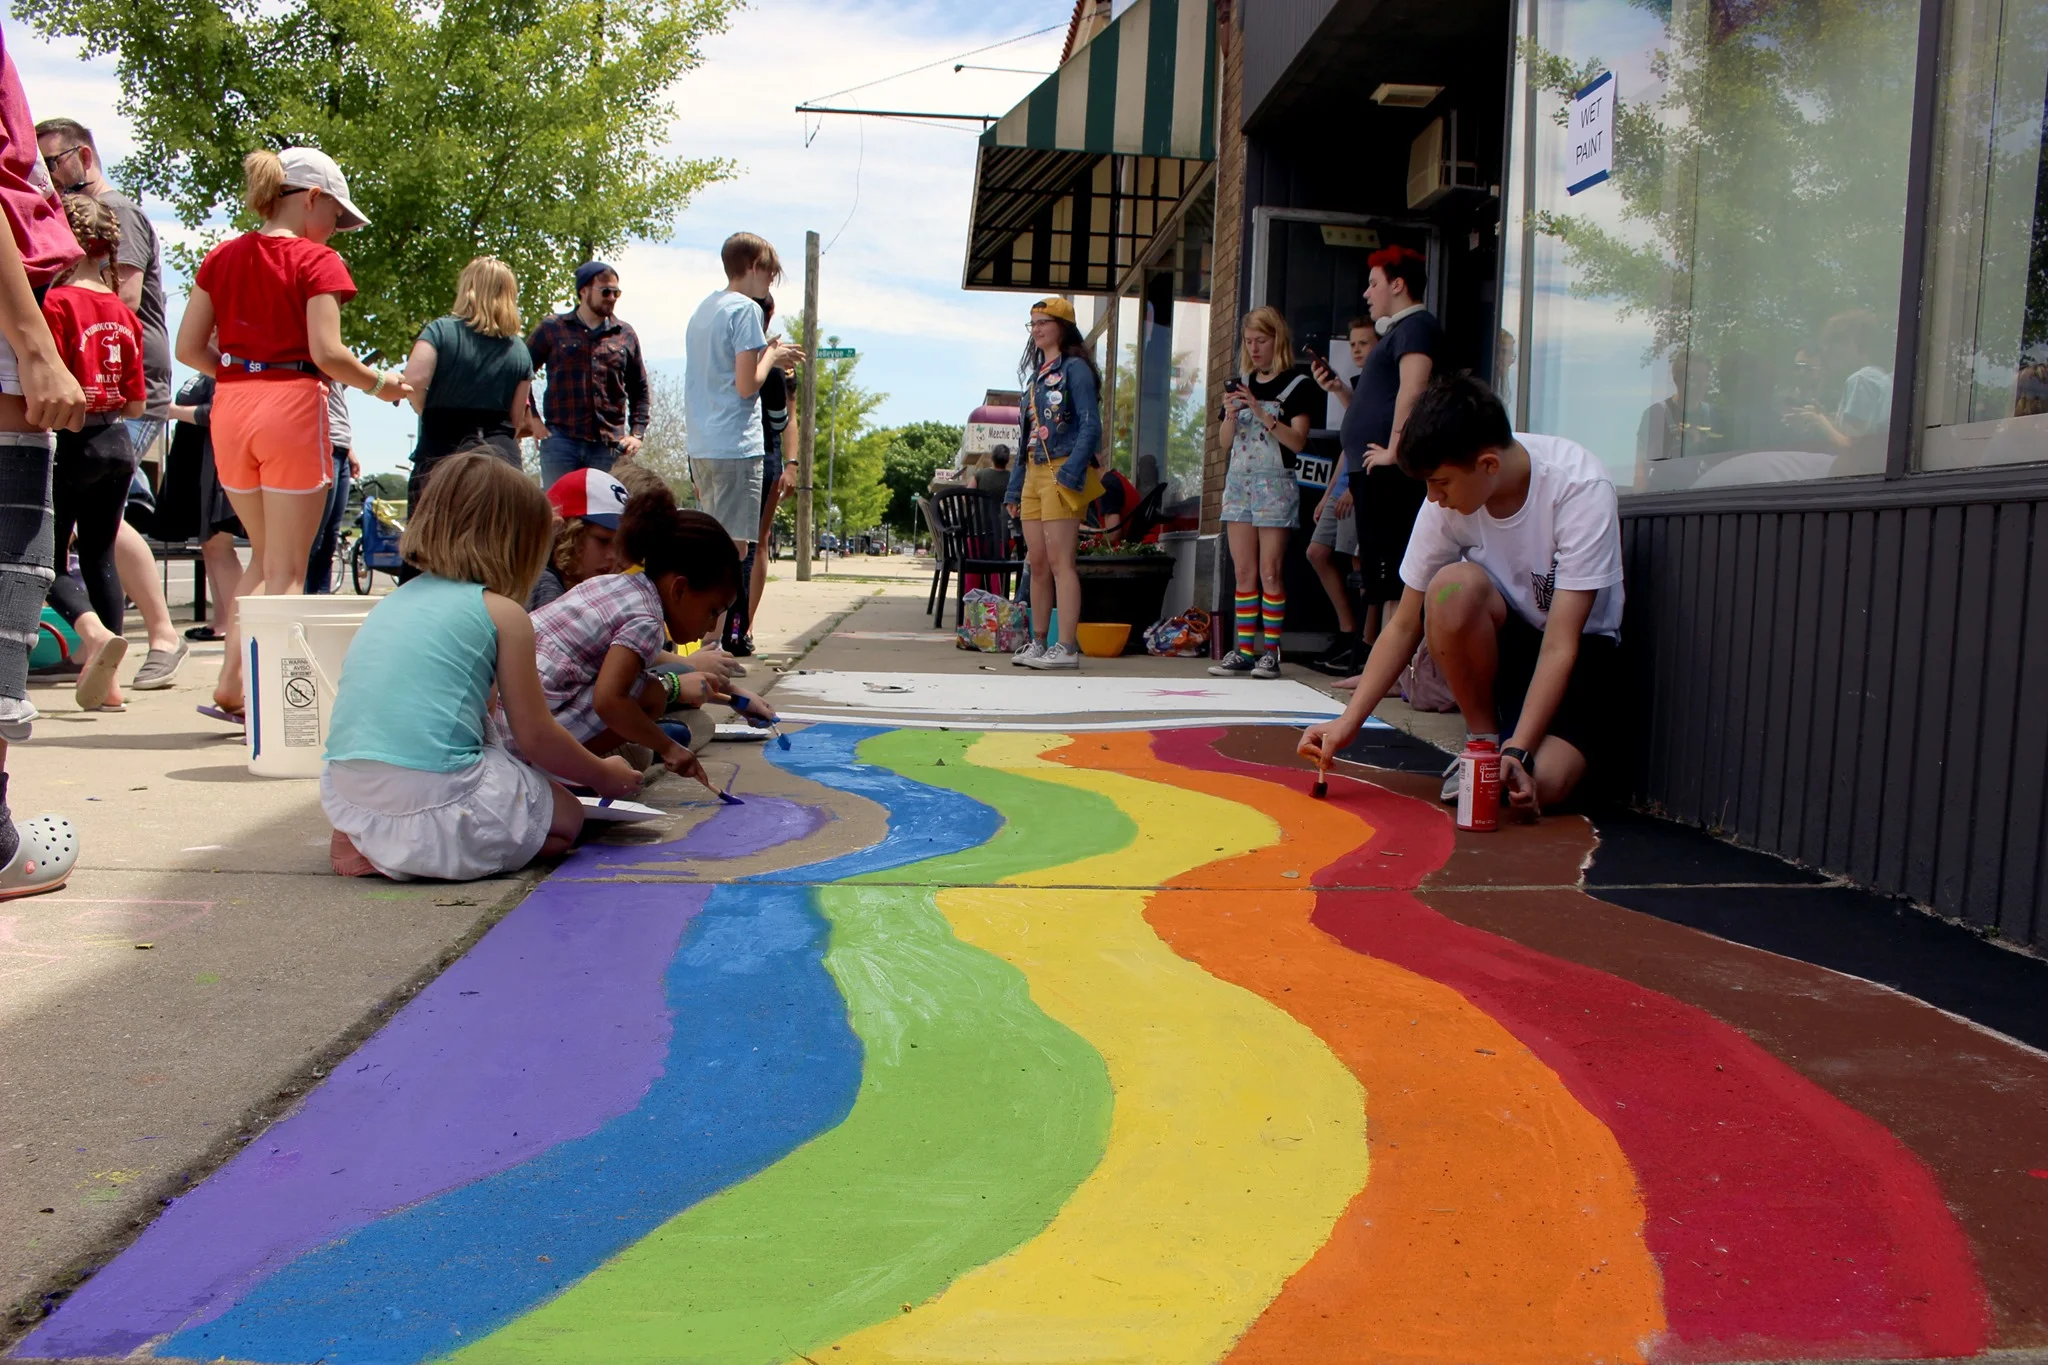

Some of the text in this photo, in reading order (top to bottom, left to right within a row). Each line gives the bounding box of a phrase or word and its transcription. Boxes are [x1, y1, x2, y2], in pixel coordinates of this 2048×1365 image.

[1581, 97, 1602, 128] WET
[1576, 130, 1603, 165] PAINT
[1295, 459, 1329, 484] PEN
